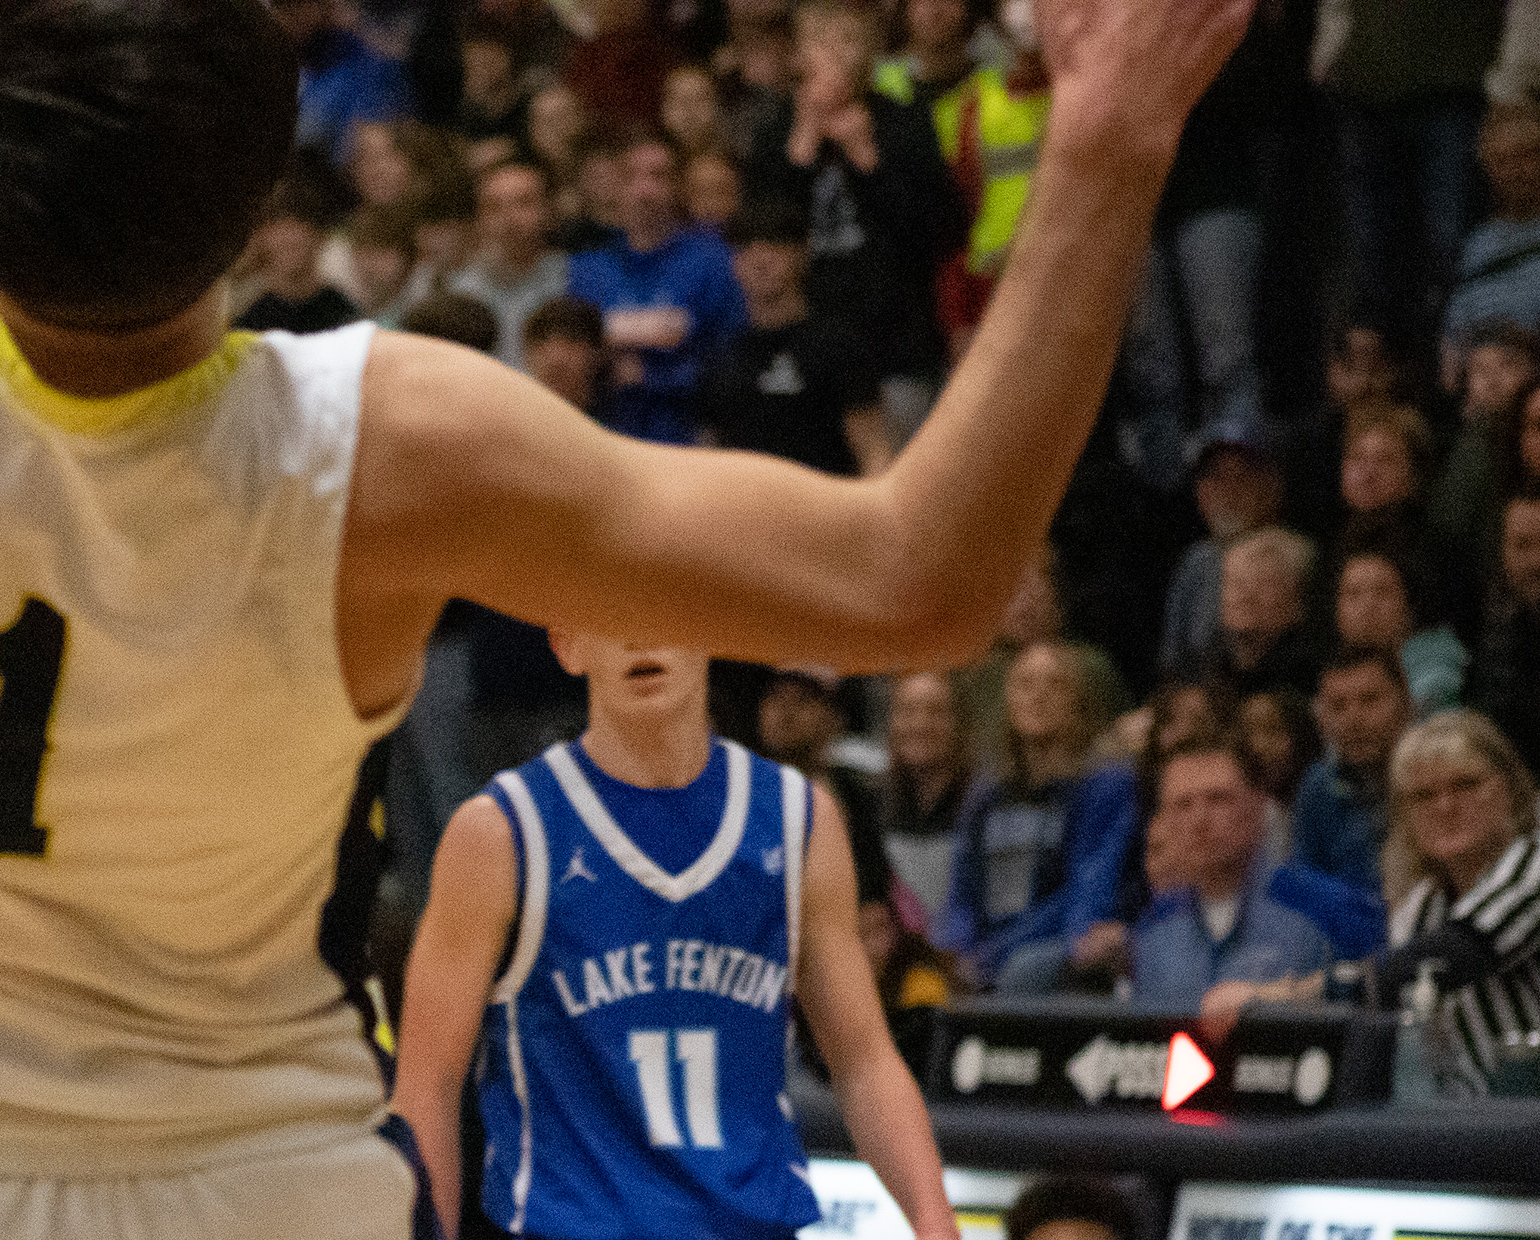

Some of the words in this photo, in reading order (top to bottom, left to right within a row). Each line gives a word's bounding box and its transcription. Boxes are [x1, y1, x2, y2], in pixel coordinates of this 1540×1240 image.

[551, 941, 657, 1017] LAKE
[665, 938, 789, 1014] FENTON
[627, 1029, 723, 1150] 11
